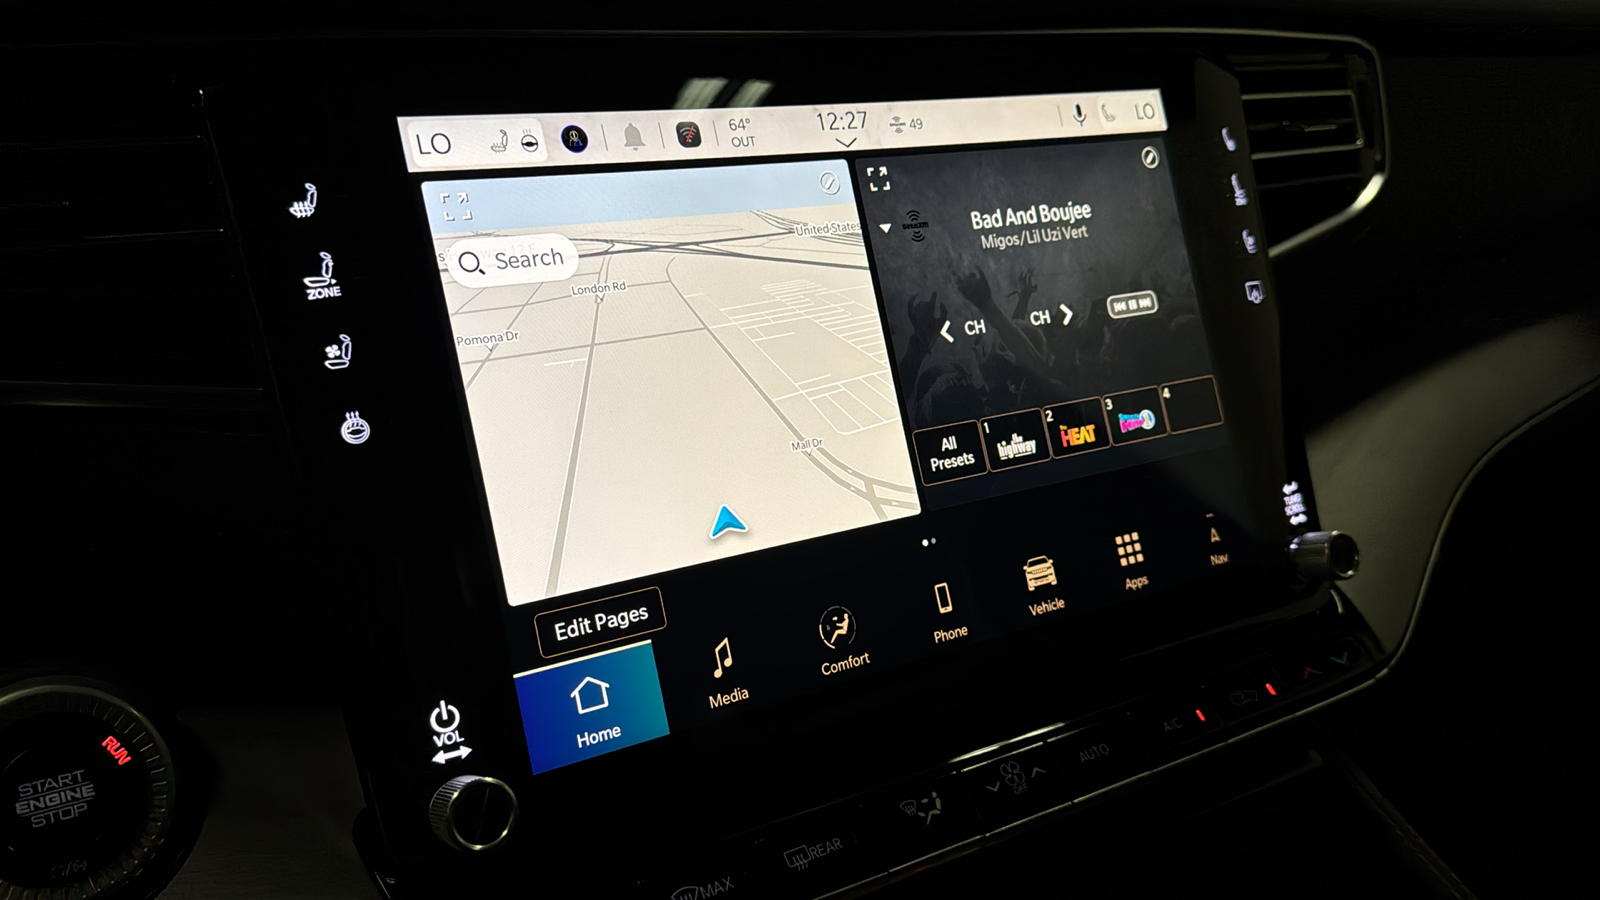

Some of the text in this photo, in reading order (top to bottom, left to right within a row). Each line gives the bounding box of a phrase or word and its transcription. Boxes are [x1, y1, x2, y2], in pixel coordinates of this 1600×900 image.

[1134, 102, 1155, 120] LO
[816, 111, 868, 132] 12:27
[909, 117, 924, 130] 49
[416, 132, 451, 155] LO
[731, 135, 756, 148] OUT
[970, 201, 1093, 231] Bad And Boujee
[795, 223, 830, 236] United
[1042, 230, 1062, 243] Uzi
[1063, 225, 1089, 241] Vert
[494, 248, 564, 270] Search
[306, 286, 342, 300] ZONE
[570, 281, 627, 296] London Rd
[1030, 310, 1051, 326] CH
[964, 320, 987, 336] CH
[456, 330, 520, 347] Pomona Dr
[1162, 387, 1171, 399] 4
[1105, 398, 1113, 410] 3
[1046, 410, 1054, 422] 2
[983, 422, 990, 434] 1
[1060, 424, 1096, 448] HEAT
[791, 438, 823, 452] Mall Dr
[941, 436, 958, 451] All
[996, 440, 1037, 459] highway
[930, 452, 975, 472] Presets
[1210, 553, 1229, 566] Nav
[1125, 575, 1149, 592] Apps
[1029, 596, 1065, 616] Vehicle
[554, 606, 649, 642] Edit Pages
[933, 624, 968, 643] Phone
[820, 652, 871, 676] Comfort
[708, 687, 750, 709] Media
[1162, 716, 1183, 732] A/C
[432, 729, 465, 747] VOL
[576, 725, 622, 748] Home
[101, 735, 132, 766] RUN
[1079, 743, 1110, 763] AUTO
[17, 769, 86, 797] START
[1012, 783, 1029, 796] OFF
[15, 783, 96, 816] ENGINE
[31, 802, 88, 828] STOP
[808, 837, 843, 860] REAR
[699, 875, 735, 899] MAX
